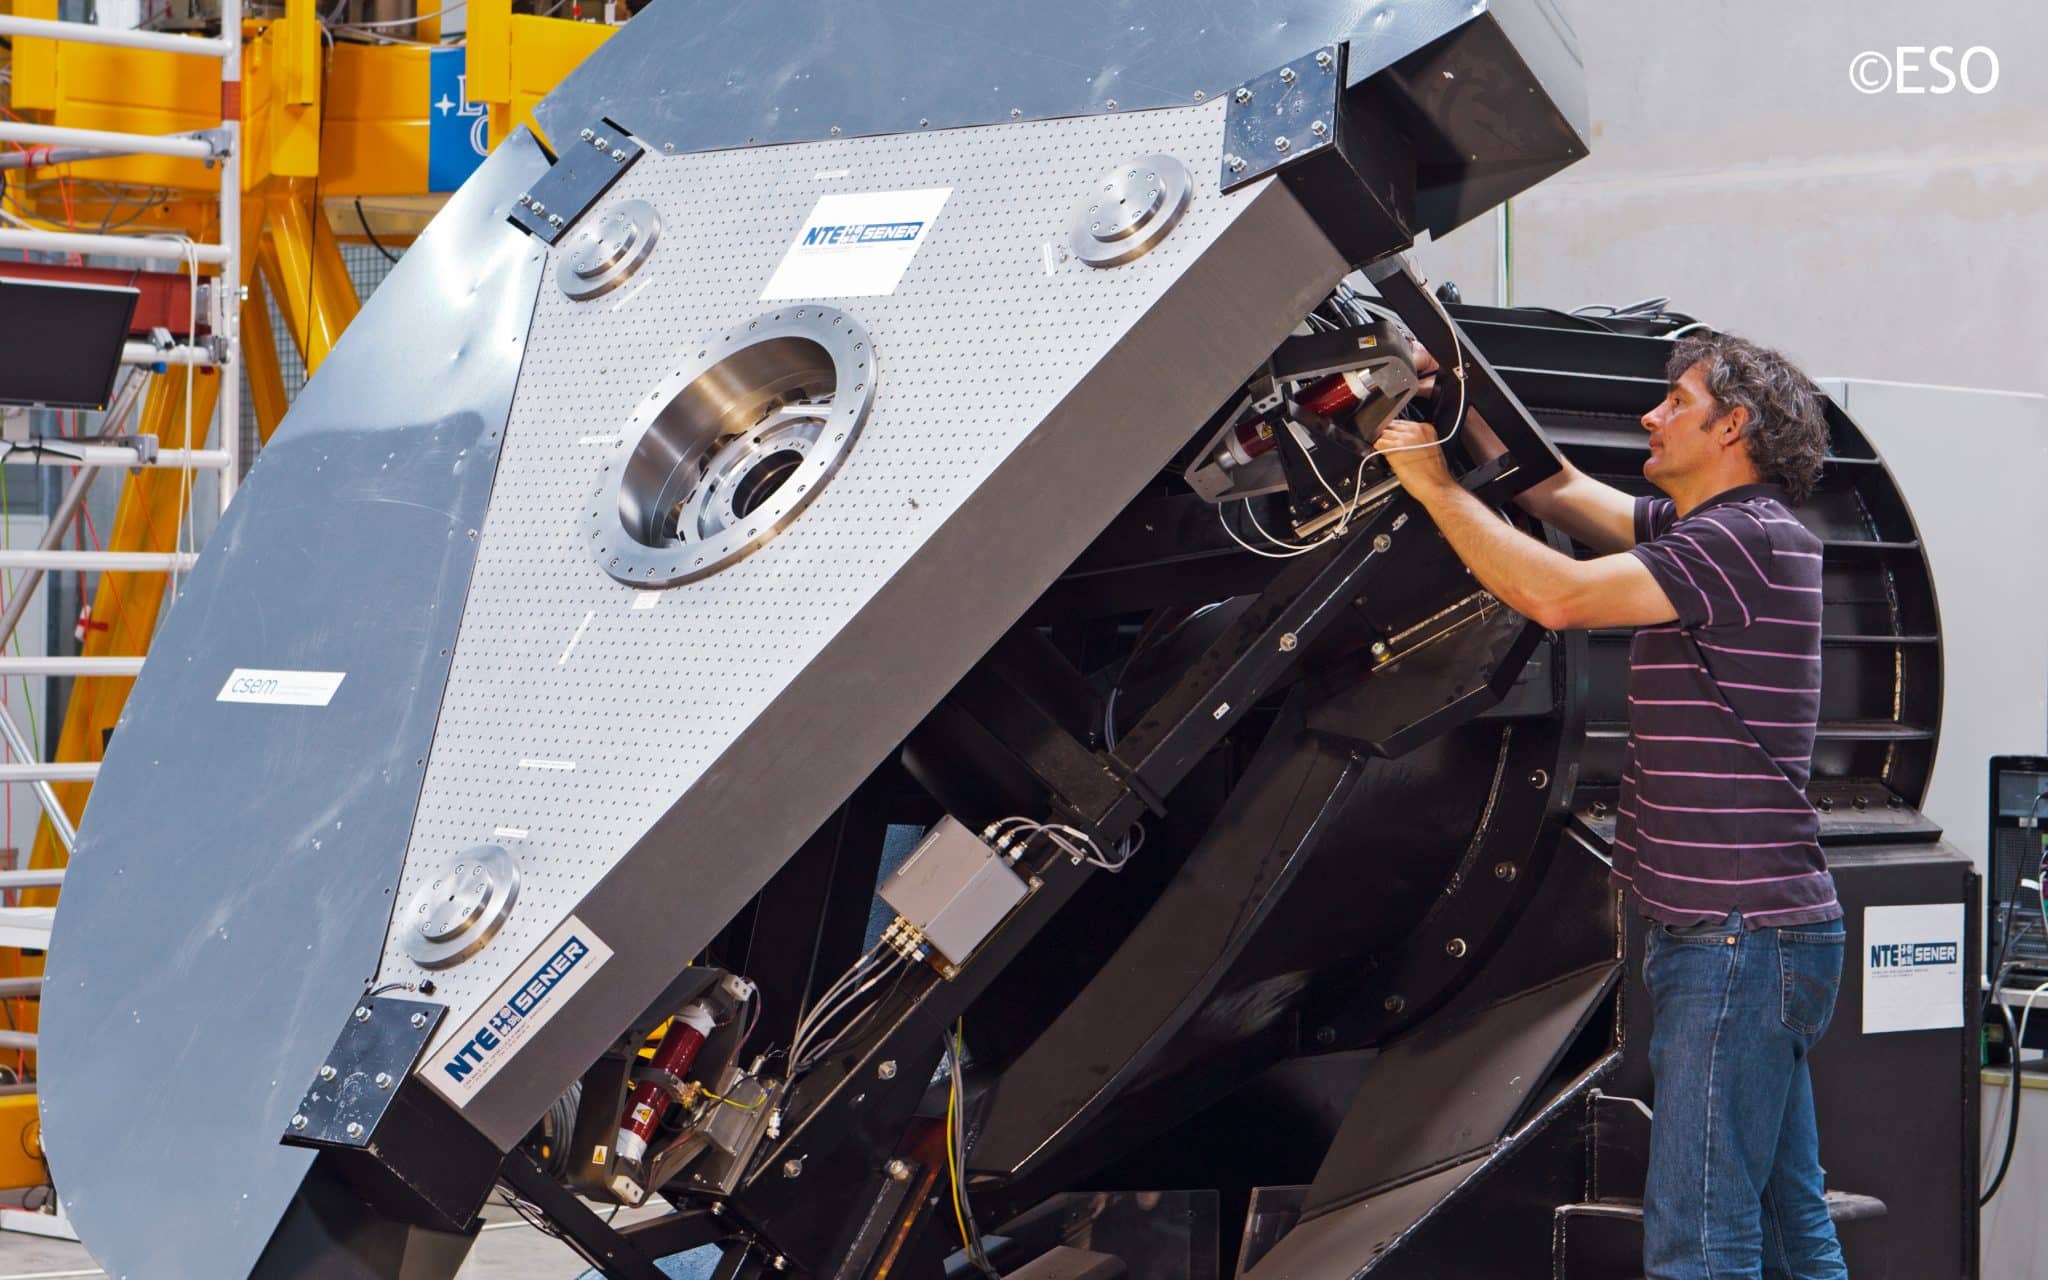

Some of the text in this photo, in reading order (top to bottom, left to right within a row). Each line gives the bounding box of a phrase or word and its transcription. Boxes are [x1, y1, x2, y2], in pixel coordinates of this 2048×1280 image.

[802, 224, 922, 246] NTE SENER
[231, 678, 278, 695] csem
[1871, 944, 1956, 968] NTE SENER
[444, 940, 585, 1083] NTE SENER
